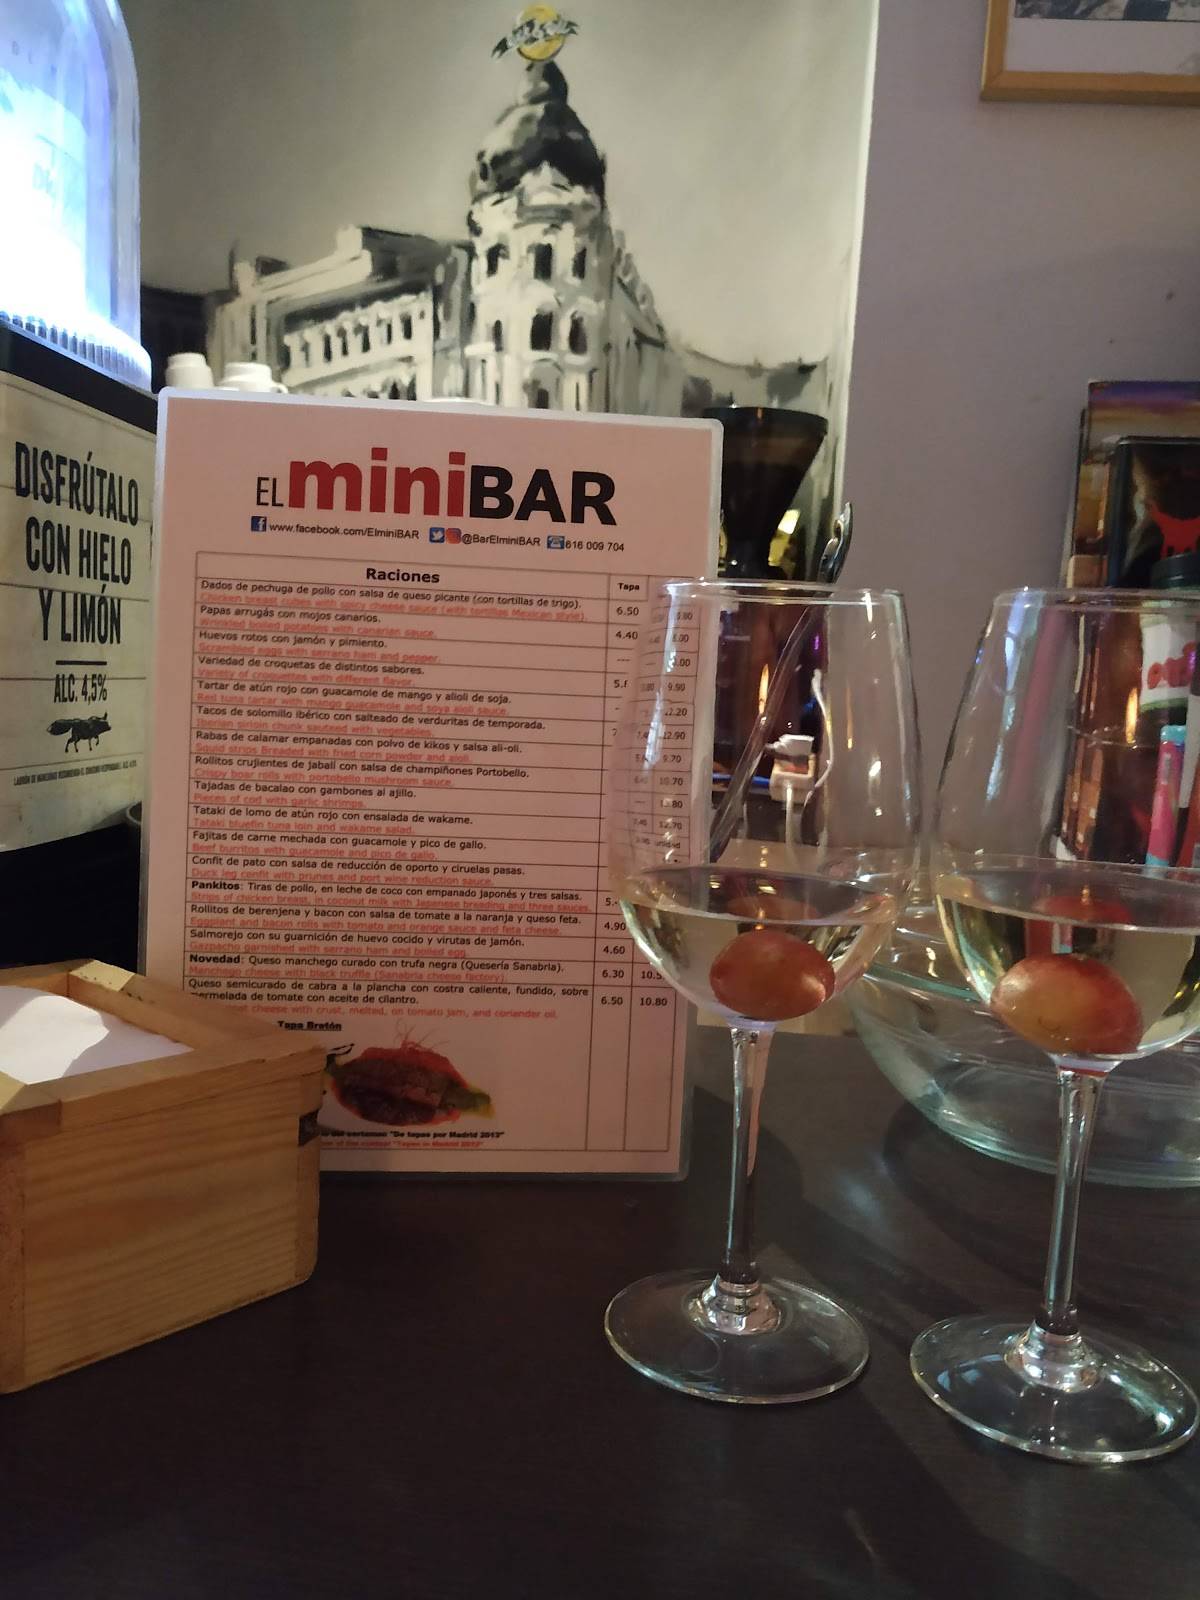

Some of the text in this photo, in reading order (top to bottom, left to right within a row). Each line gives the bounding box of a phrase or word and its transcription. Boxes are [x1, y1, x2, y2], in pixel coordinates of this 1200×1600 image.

[15, 441, 139, 526] DISFRÚTALO
[255, 476, 284, 507] EL
[26, 517, 132, 586] CON HIELO
[586, 541, 604, 551] 009
[607, 541, 625, 552] 704
[365, 567, 440, 584] Raciones
[200, 580, 232, 589] Dados
[235, 582, 248, 590] de
[250, 583, 293, 594] pechuga
[296, 585, 309, 593] de
[311, 586, 335, 596] pollo
[358, 589, 384, 597] salsa
[386, 590, 399, 598] de
[401, 593, 431, 601] queso
[433, 593, 470, 603] picante
[497, 596, 533, 605] tortillas
[536, 598, 548, 606] de
[618, 582, 640, 593] Tapa
[38, 584, 122, 645] Y LIMÓN
[199, 605, 231, 616] Papas
[298, 610, 331, 621] mojos
[616, 606, 640, 617] 6.50
[615, 630, 639, 641] 4.40
[197, 656, 244, 665] Variedad
[247, 658, 261, 666] de
[263, 659, 315, 670] croquetas
[334, 663, 378, 672] distintos
[53, 674, 108, 704] ALC. 4,5%
[196, 706, 227, 715] Tacos
[246, 709, 292, 718] solomillo
[354, 713, 398, 722] salteado
[401, 715, 414, 723] de
[417, 716, 469, 725] verduritas
[471, 718, 485, 726] de
[194, 757, 234, 765] Rollitos
[236, 758, 288, 769] crujientes
[290, 760, 304, 768] de
[360, 763, 387, 771] salsa
[389, 764, 403, 772] de
[405, 765, 473, 776] champiñones
[192, 807, 225, 815] Tataki
[228, 808, 242, 816] de
[245, 809, 271, 817] lomo
[290, 810, 314, 818] atún
[317, 811, 338, 820] rojo
[362, 813, 408, 821] ensalada
[411, 814, 425, 822] de
[191, 832, 228, 841] Fajitas
[279, 835, 326, 843] mechada
[350, 837, 407, 847] guacamole
[418, 839, 441, 848] pico
[191, 856, 223, 864] Confit
[242, 858, 266, 867] pato
[336, 861, 386, 870] reducción
[404, 863, 439, 873] oporto
[450, 865, 490, 873] ciruelas
[604, 922, 627, 932] 4.90
[188, 930, 244, 940] Salmorejo
[282, 933, 338, 942] guarnición
[390, 935, 424, 943] cocido
[603, 945, 626, 956] 4.60
[248, 956, 281, 966] Queso
[284, 957, 338, 967] manchego
[400, 960, 425, 968] trufa
[428, 962, 457, 970] negra
[602, 969, 625, 980] 6.30
[641, 970, 665, 981] 10.5
[187, 979, 222, 989] Queso
[225, 980, 286, 988] semicurado
[307, 982, 337, 990] cabra
[366, 983, 406, 993] plancha
[266, 992, 303, 1000] tomate
[601, 996, 624, 1007] 6.50
[639, 997, 668, 1008] 10.80
